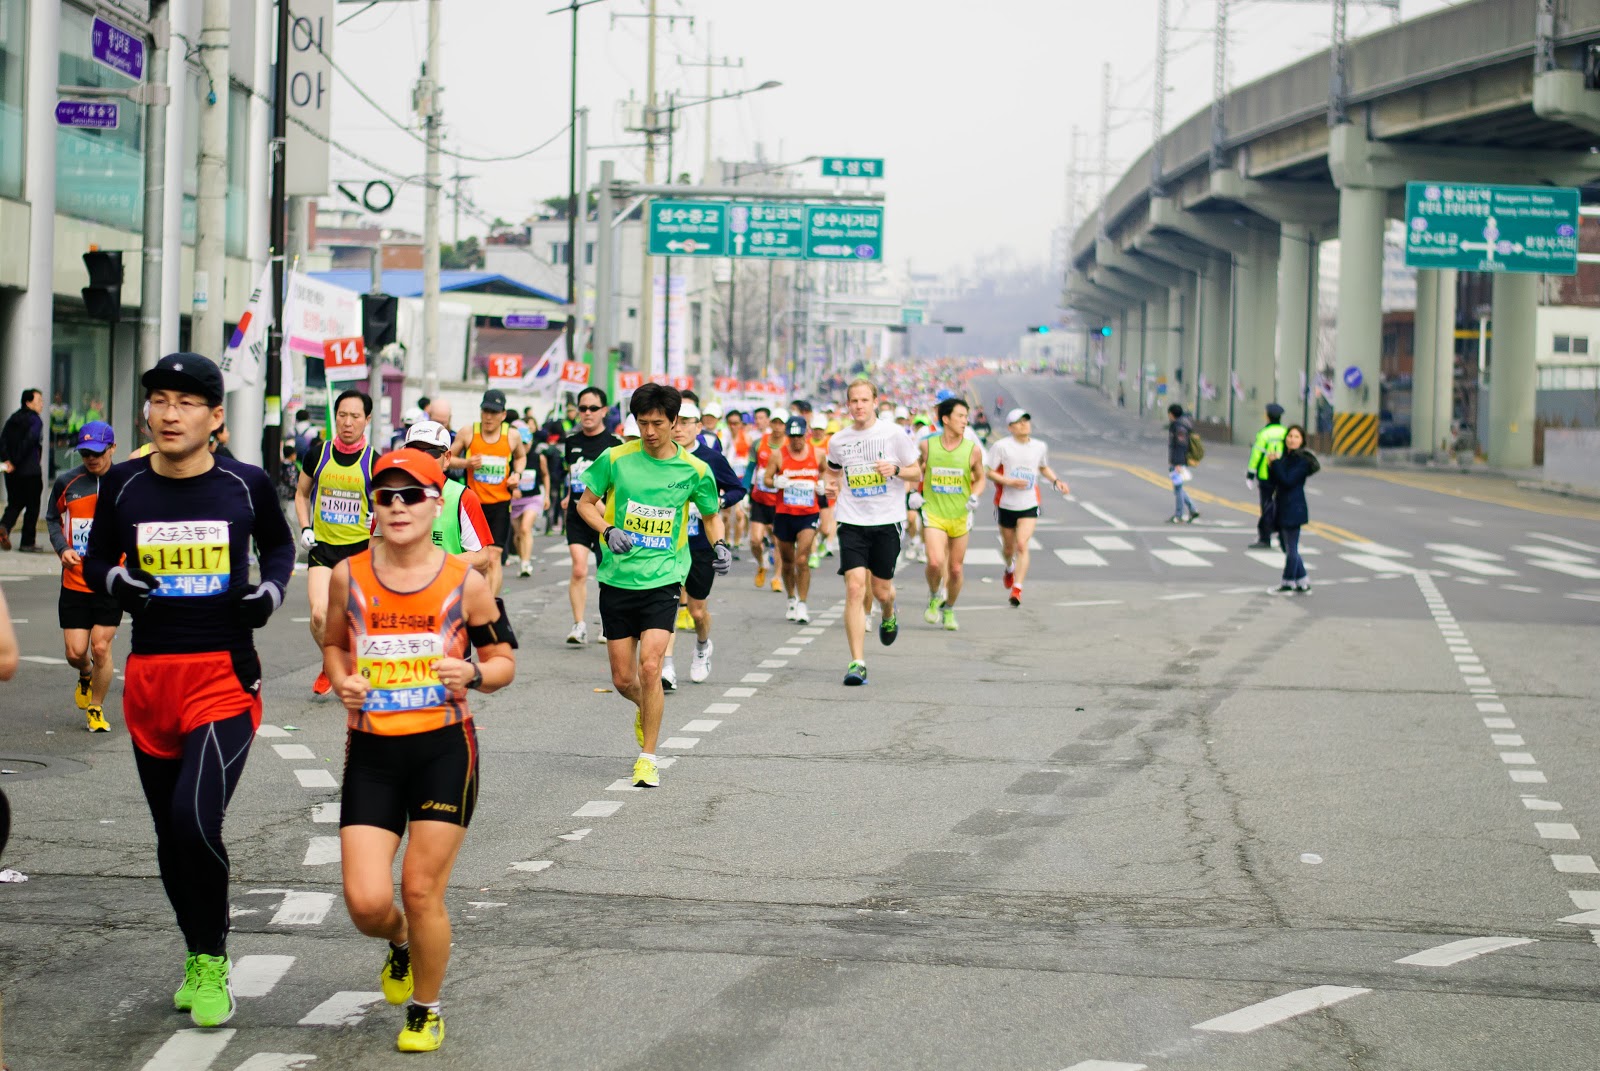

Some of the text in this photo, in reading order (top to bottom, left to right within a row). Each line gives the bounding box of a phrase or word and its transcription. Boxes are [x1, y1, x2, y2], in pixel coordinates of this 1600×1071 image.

[77, 105, 116, 119] 서울숲길
[813, 212, 879, 228] 성수사거리
[331, 341, 359, 364] 14
[494, 357, 519, 377] 13
[566, 364, 588, 382] 12
[328, 502, 360, 513] 18010
[147, 525, 221, 543] 스포츠동아
[633, 517, 671, 534] 34142
[641, 536, 667, 548] 채널A
[156, 546, 224, 570] 14117
[175, 576, 222, 595] 채널A
[371, 612, 436, 632] 일산호수마라톤
[364, 639, 436, 656] 스포츠동아
[390, 686, 440, 708] 채널A
